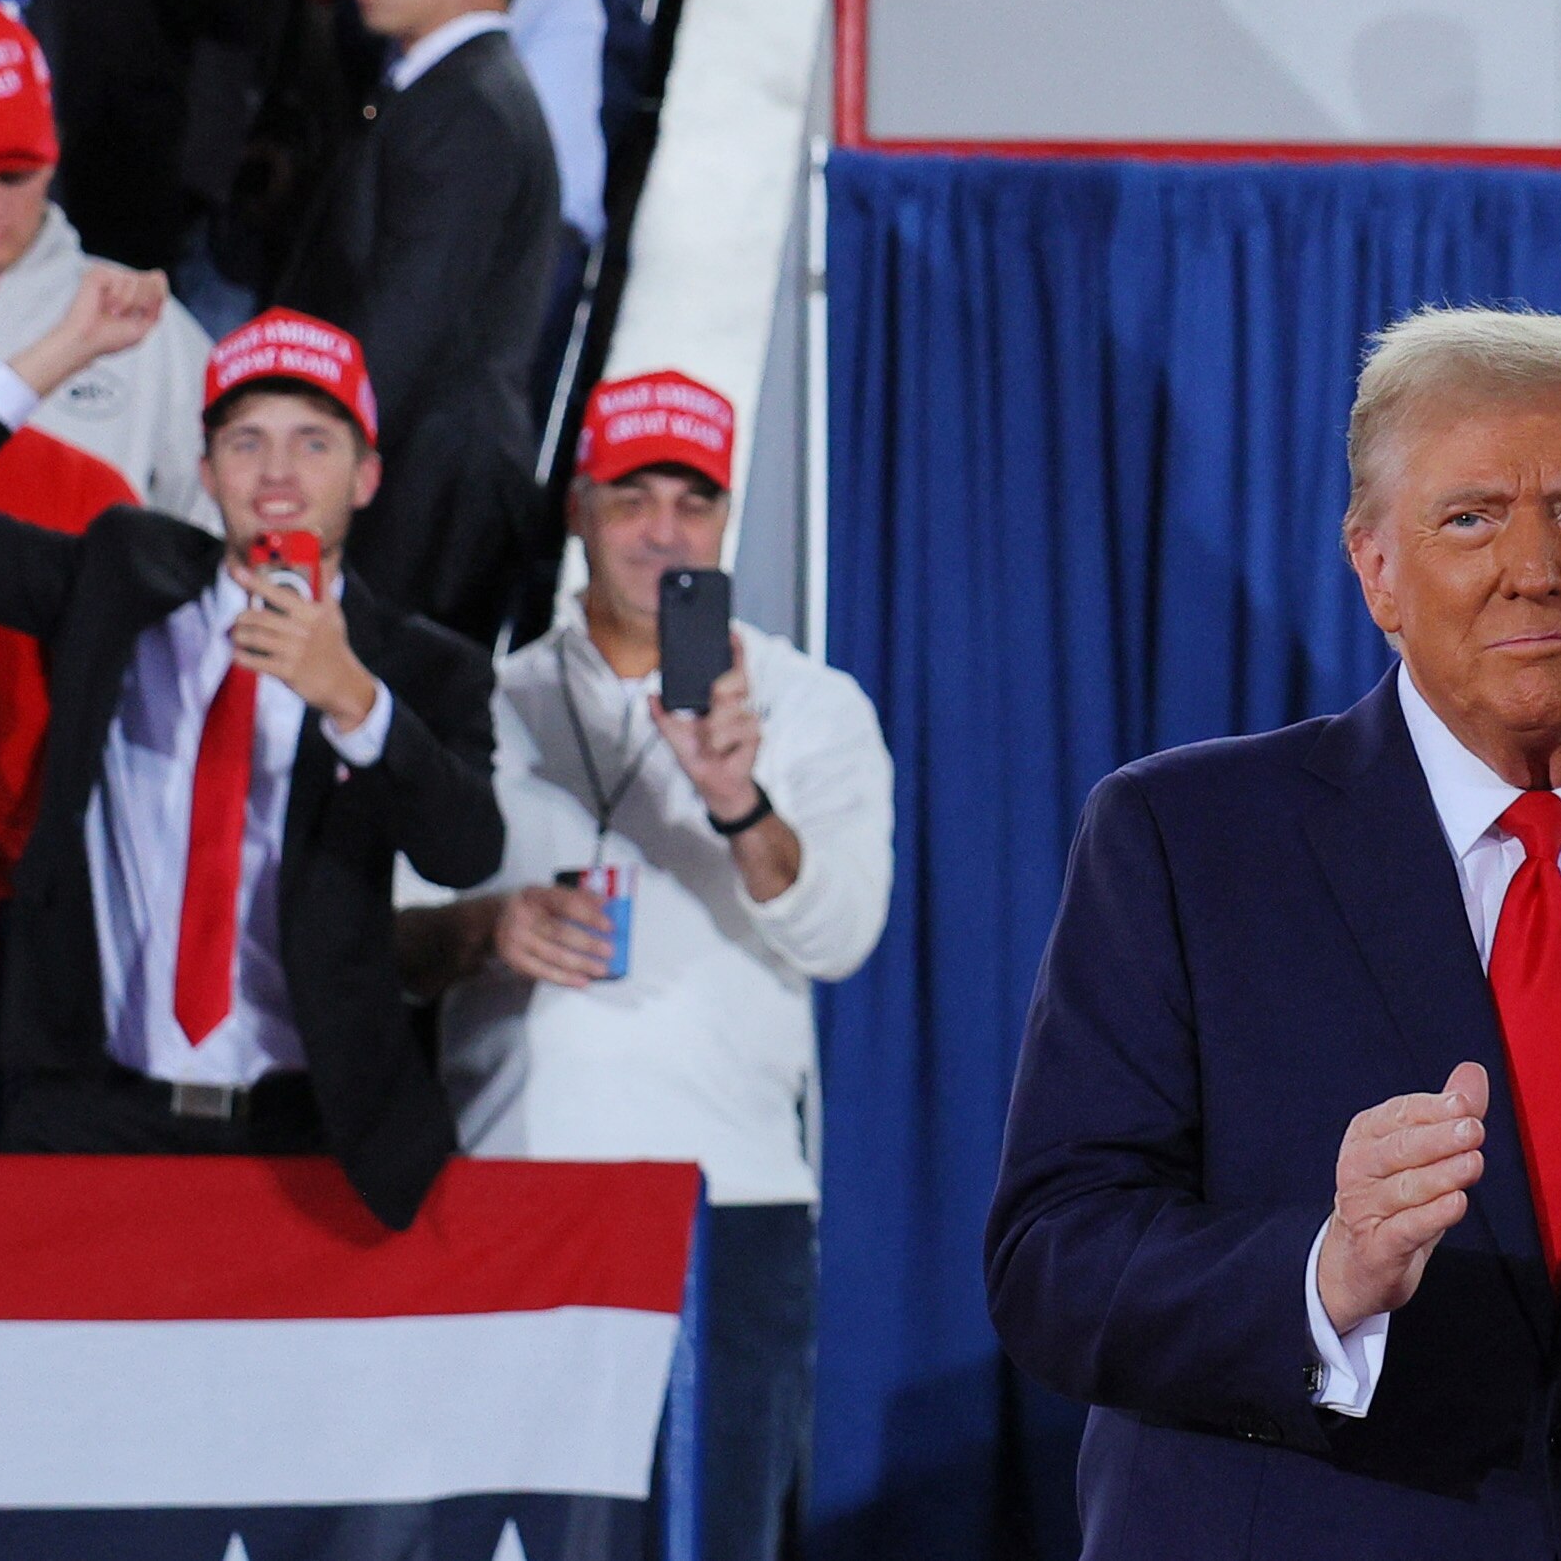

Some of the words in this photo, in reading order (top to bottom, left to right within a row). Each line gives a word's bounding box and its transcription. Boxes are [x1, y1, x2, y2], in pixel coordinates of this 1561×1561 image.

[264, 318, 354, 365] AMERICA
[216, 345, 277, 389] GREAT
[279, 347, 342, 385] AGAIN
